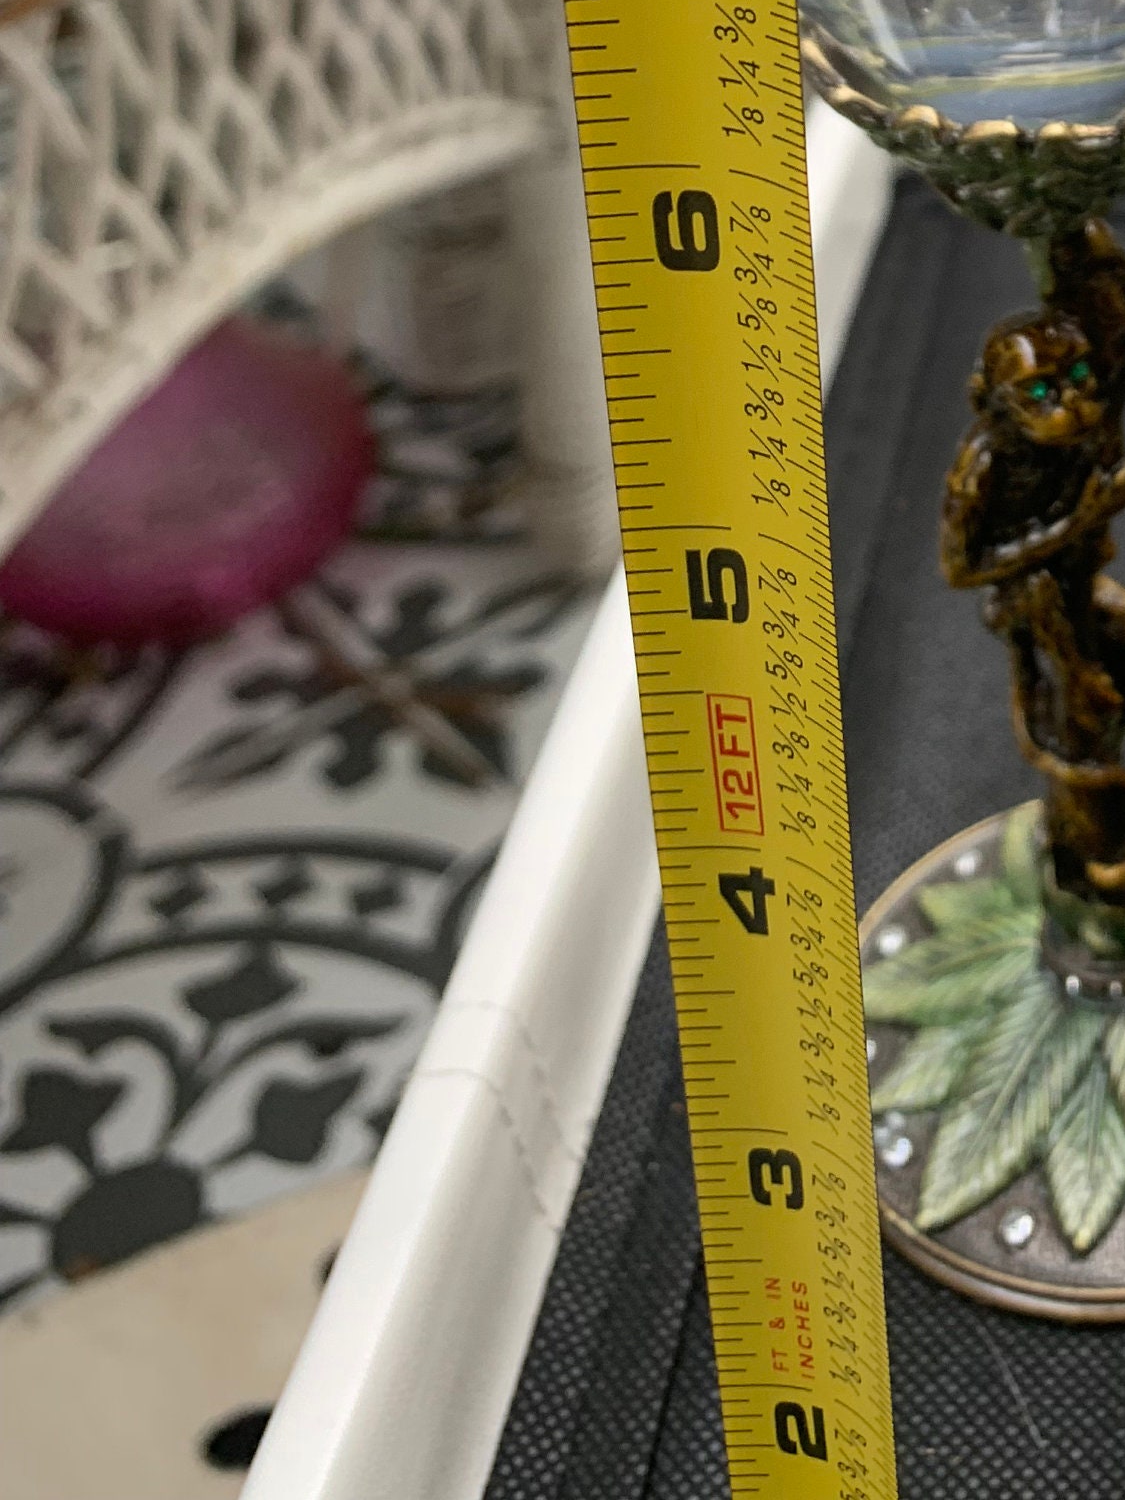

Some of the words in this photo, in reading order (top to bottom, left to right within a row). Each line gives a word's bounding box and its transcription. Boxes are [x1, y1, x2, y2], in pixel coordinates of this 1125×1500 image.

[714, 2, 757, 47] 3/8
[718, 53, 761, 98] 1/4
[722, 102, 765, 147] 1/8
[652, 189, 720, 272] 6
[730, 201, 771, 243] 7/8
[734, 245, 774, 287] 3/4
[737, 292, 777, 335] 5/8
[741, 338, 781, 383] 1/2
[744, 382, 785, 427] 3/8
[748, 428, 788, 472] 1/4
[751, 472, 791, 517] 1/8
[685, 547, 750, 624] 5
[758, 561, 797, 605] 7/8
[762, 601, 800, 645] 3/4
[765, 643, 804, 687] 5/8
[769, 684, 807, 729] 1/2
[715, 703, 750, 759] FT
[772, 724, 810, 767] 3/8
[722, 769, 756, 820] 12
[776, 764, 813, 808] 1/4
[779, 803, 817, 846] 1/8
[718, 865, 776, 936] 4
[786, 880, 823, 924] 7/8
[790, 916, 826, 959] 3/4
[793, 953, 829, 995] 5/8
[796, 989, 832, 1032] 1/2
[799, 1024, 835, 1065] 3/8
[803, 1059, 838, 1100] 1/4
[748, 1147, 804, 1211] 3
[765, 1277, 781, 1300] IN
[768, 1317, 786, 1330] &
[791, 1281, 816, 1381] INCHES
[771, 1348, 789, 1373] FT
[774, 1401, 828, 1463] 2
